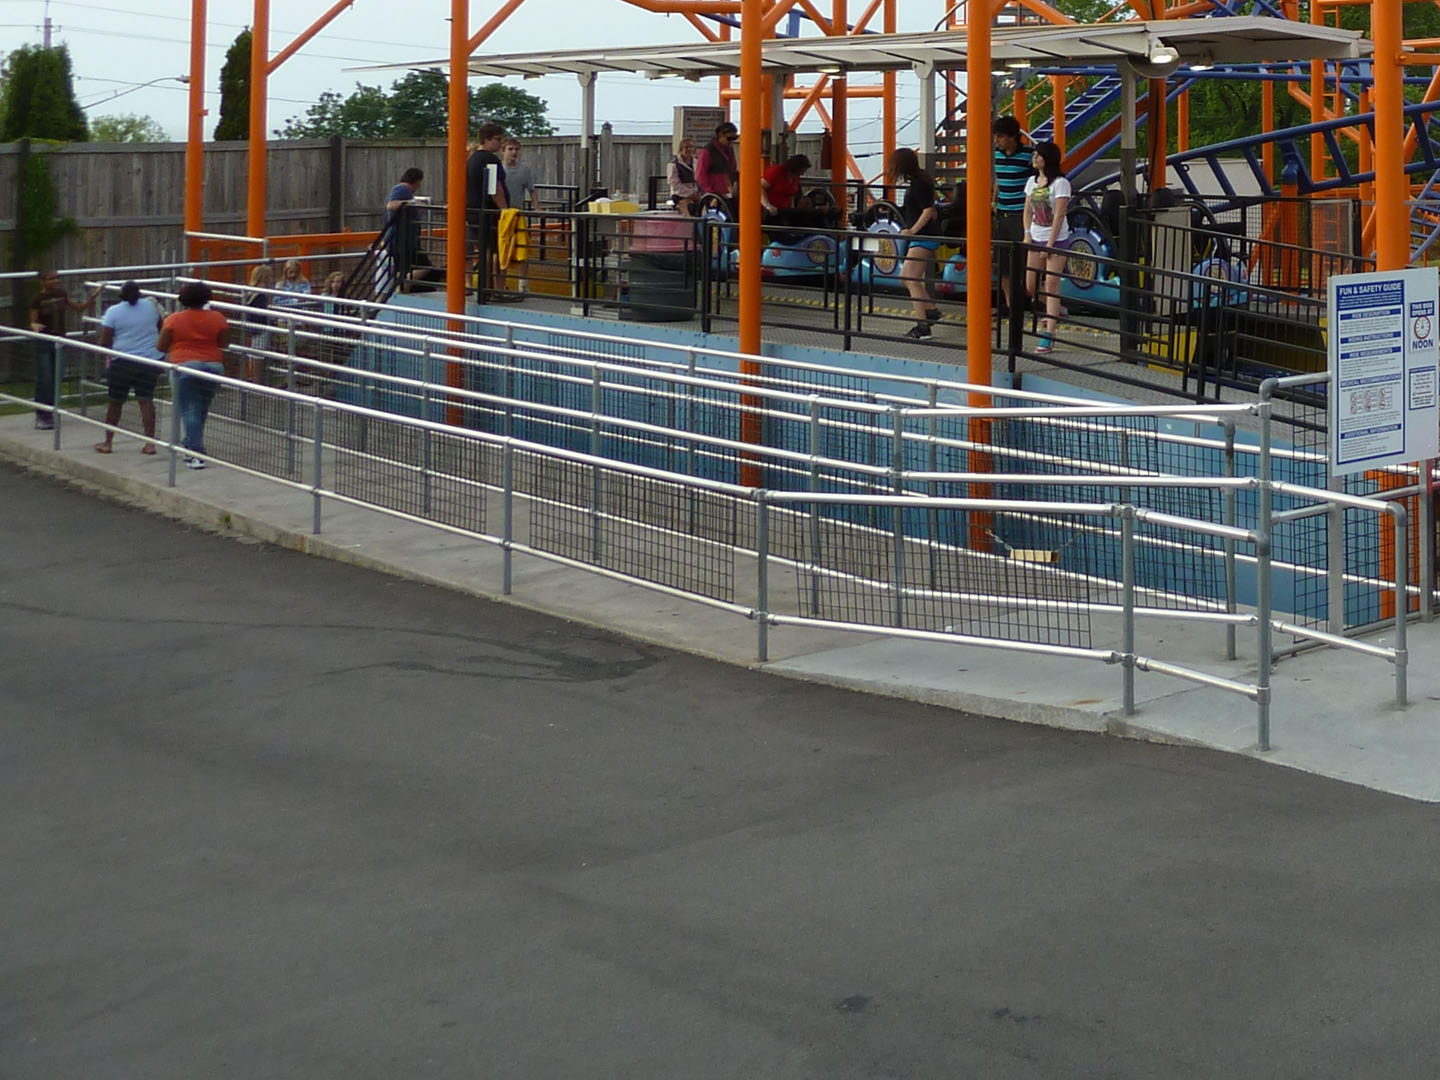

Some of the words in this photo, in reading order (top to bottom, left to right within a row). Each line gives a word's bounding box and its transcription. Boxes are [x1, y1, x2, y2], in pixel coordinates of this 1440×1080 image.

[1340, 287, 1352, 295] FUN
[1353, 286, 1358, 294] &
[1359, 284, 1382, 293] SAFETY
[1383, 282, 1402, 291] GUIDE
[1412, 339, 1433, 350] NOON
